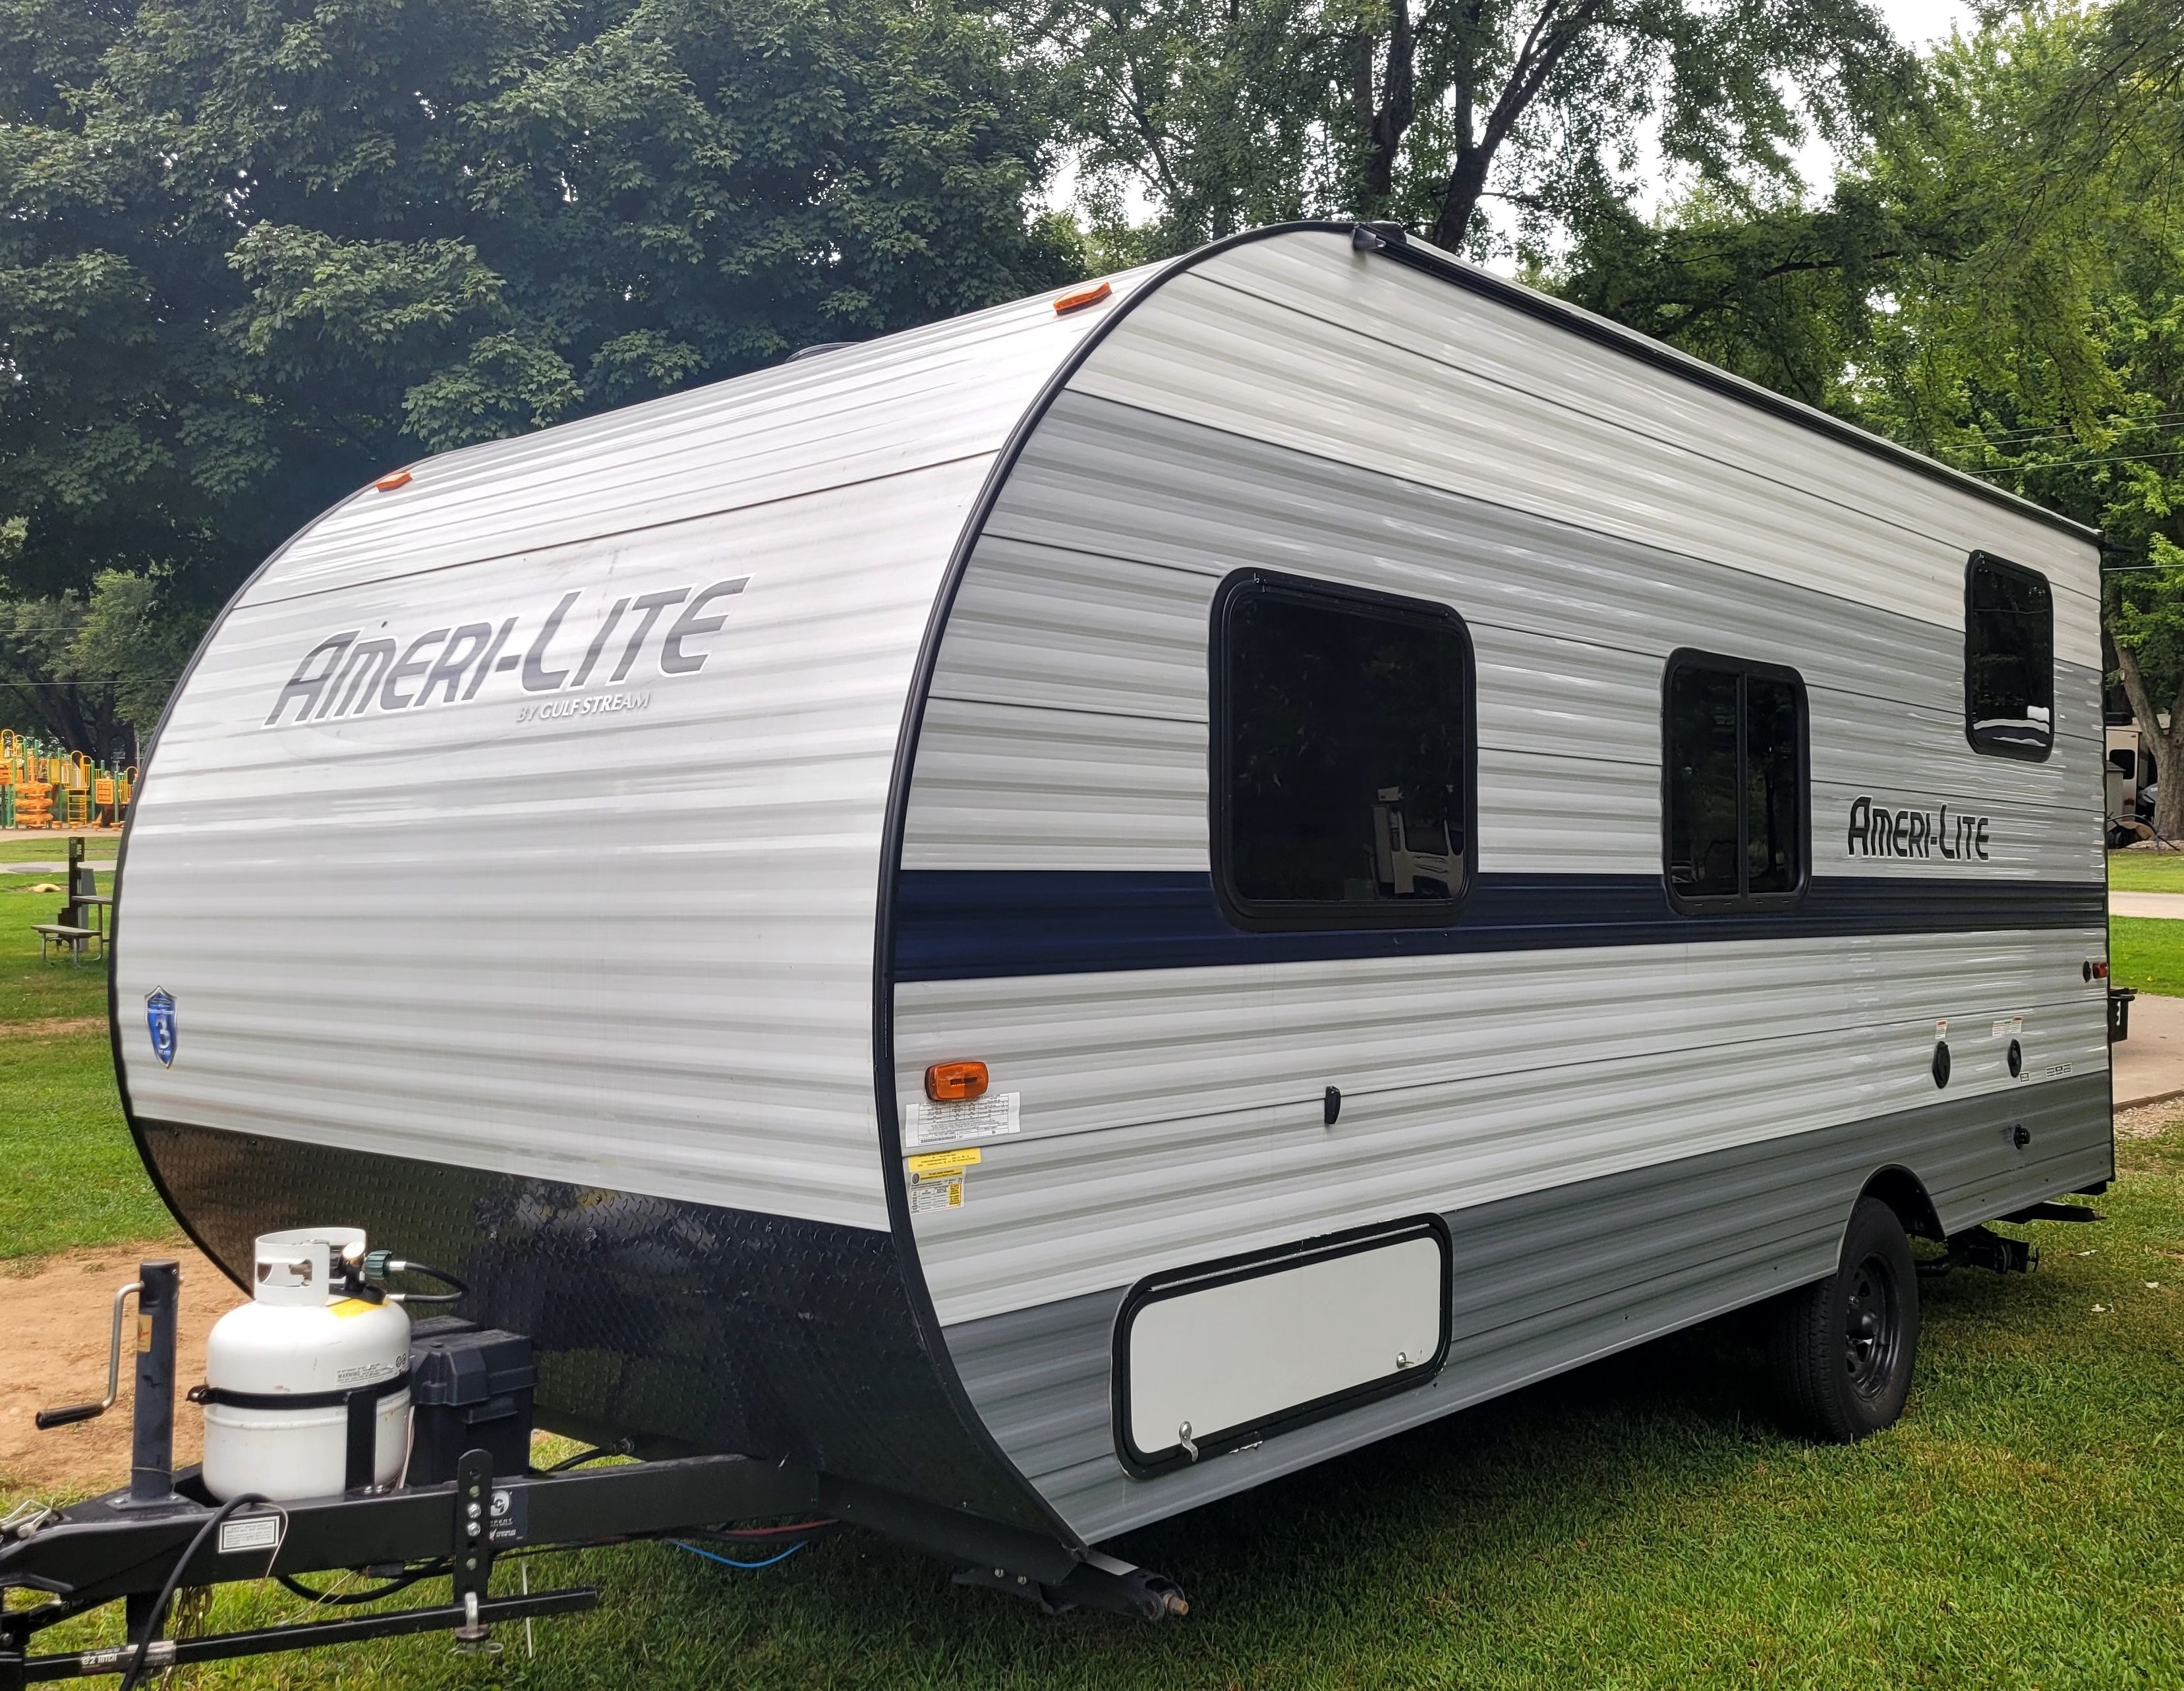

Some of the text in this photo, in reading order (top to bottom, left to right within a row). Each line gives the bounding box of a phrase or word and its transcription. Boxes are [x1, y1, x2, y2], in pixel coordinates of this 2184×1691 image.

[517, 692, 652, 722] BY GULF STREAM
[156, 1015, 171, 1049] 3
